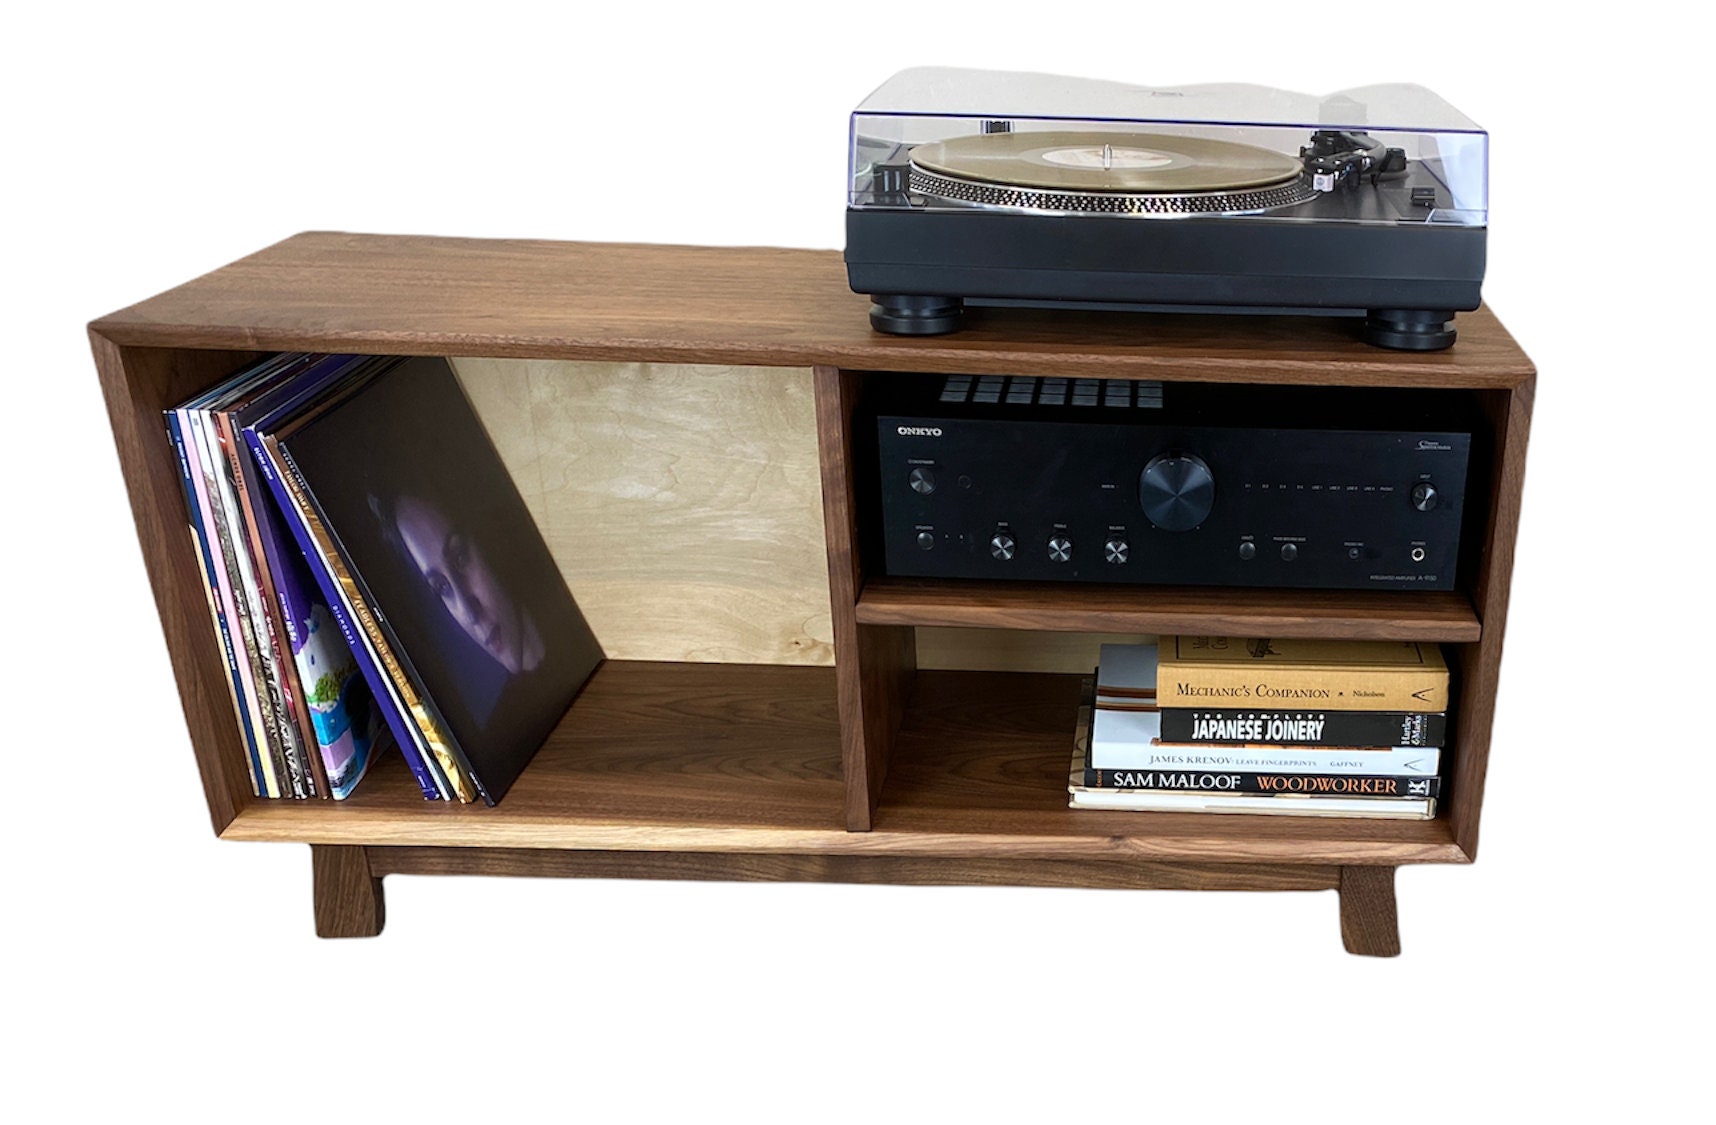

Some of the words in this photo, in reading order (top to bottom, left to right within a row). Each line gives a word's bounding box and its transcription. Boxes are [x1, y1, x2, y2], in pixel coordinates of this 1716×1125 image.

[897, 425, 943, 437] ONKYO
[1176, 682, 1250, 697] MECHANIC'S
[1255, 684, 1330, 699] COMPANION
[1192, 720, 1262, 739] JAPANESE
[1265, 720, 1325, 740] JOINERY
[1149, 755, 1184, 765] JAMES
[1113, 772, 1153, 788] SAM
[1158, 773, 1241, 789] MALOOF
[1257, 776, 1397, 794] WOODWORKER
